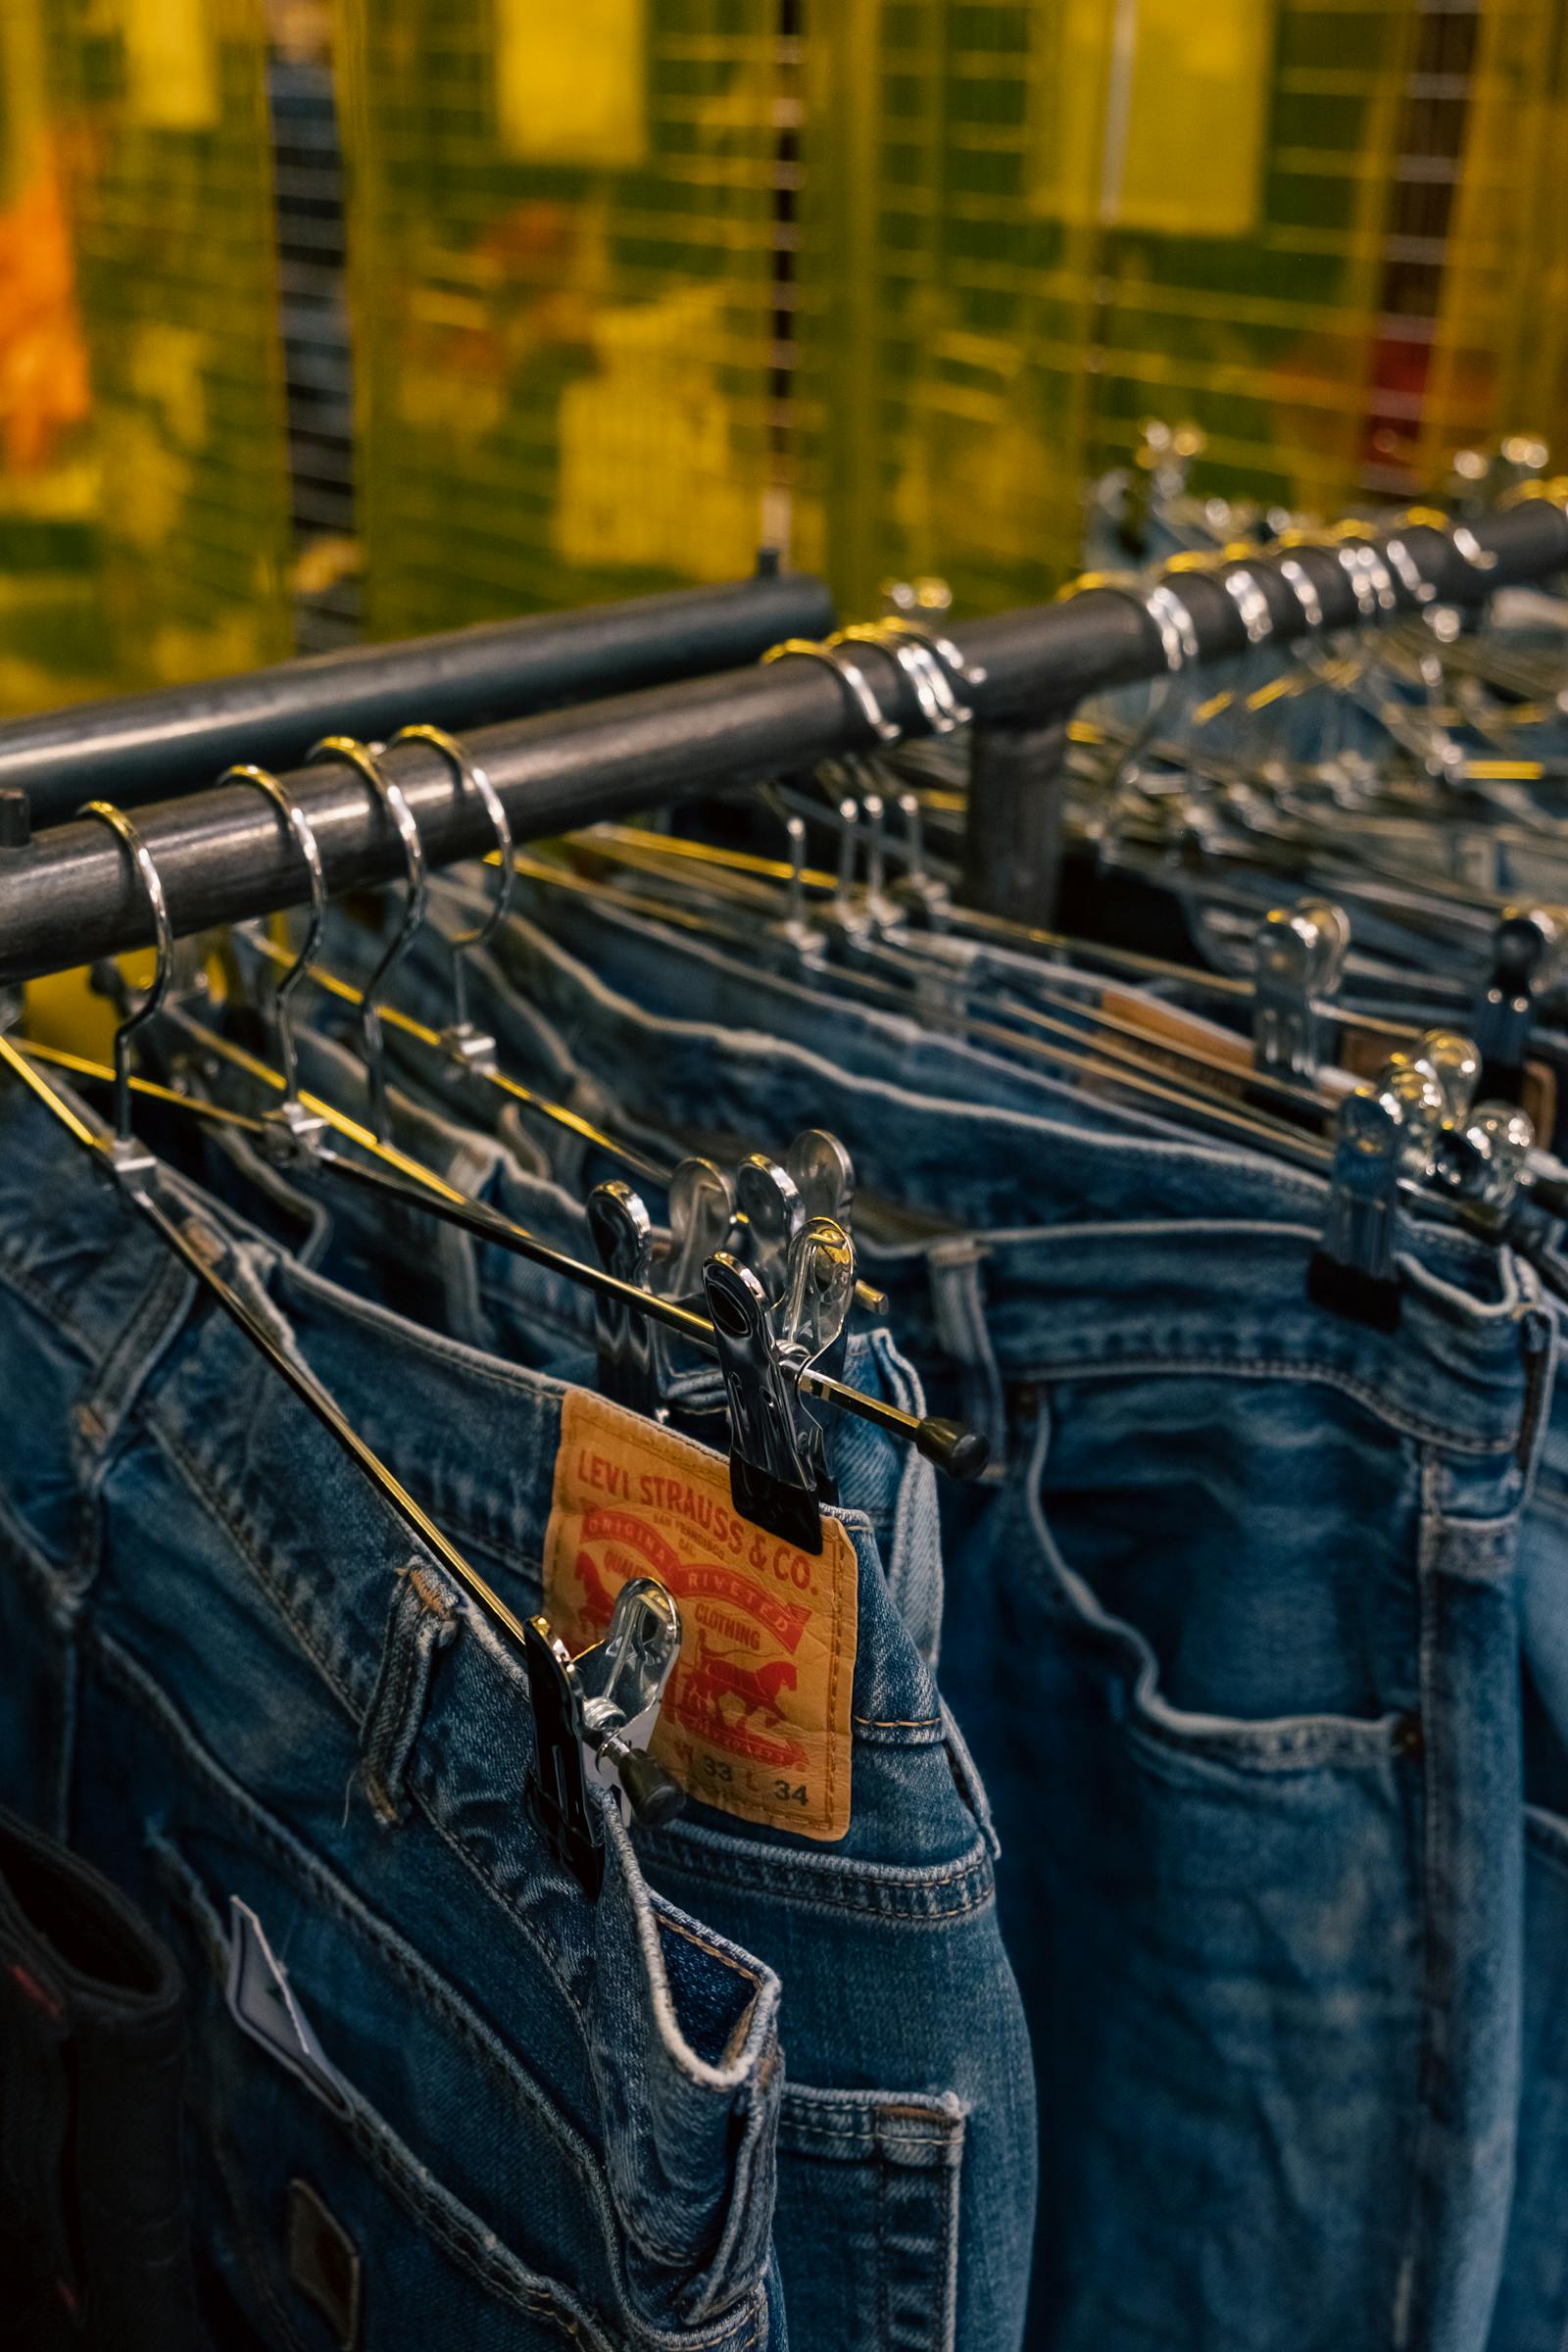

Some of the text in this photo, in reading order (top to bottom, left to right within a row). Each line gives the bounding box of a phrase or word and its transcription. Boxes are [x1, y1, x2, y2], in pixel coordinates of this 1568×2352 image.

[577, 1449, 819, 1596] LEVI STRAUSS & CO.
[688, 1571, 788, 1632] RIVETED
[695, 1602, 760, 1651] CLOTHING
[703, 1755, 733, 1783] 33
[773, 1779, 809, 1807] 34
